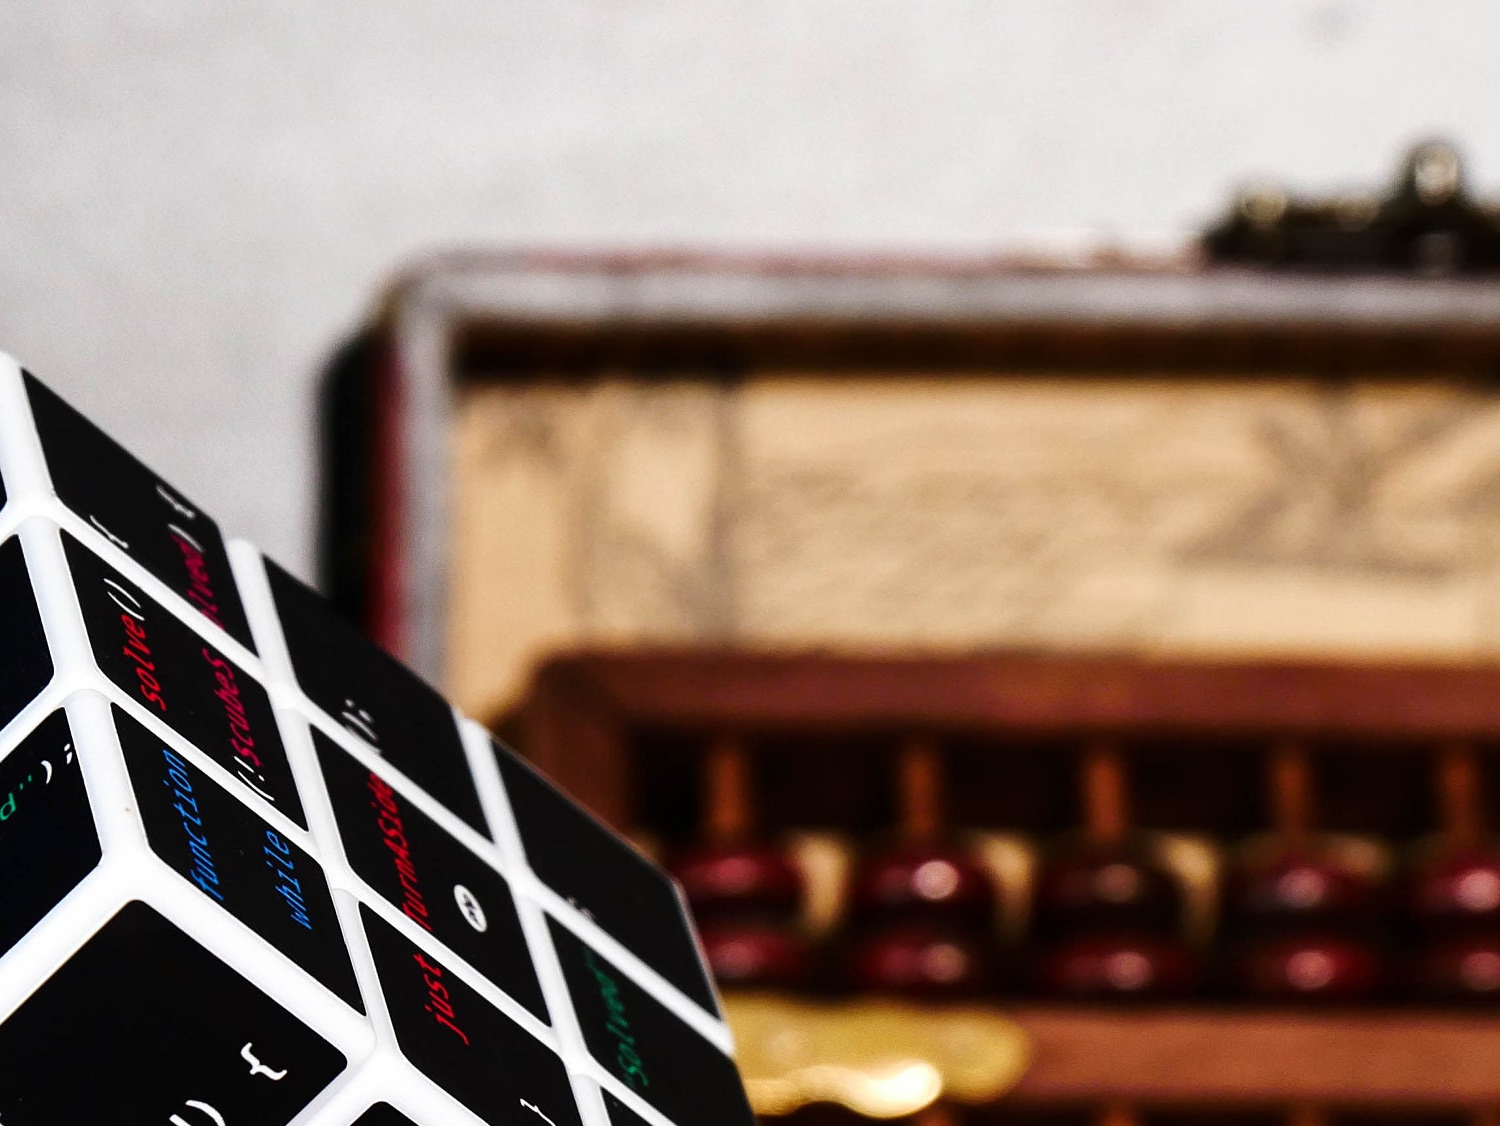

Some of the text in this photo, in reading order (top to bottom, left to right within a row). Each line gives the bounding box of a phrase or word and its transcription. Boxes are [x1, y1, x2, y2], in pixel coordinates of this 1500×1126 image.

[103, 577, 167, 711] solve()
[162, 749, 224, 901] function
[263, 829, 312, 930] while
[413, 953, 470, 1045] just
[240, 1042, 288, 1081] {
